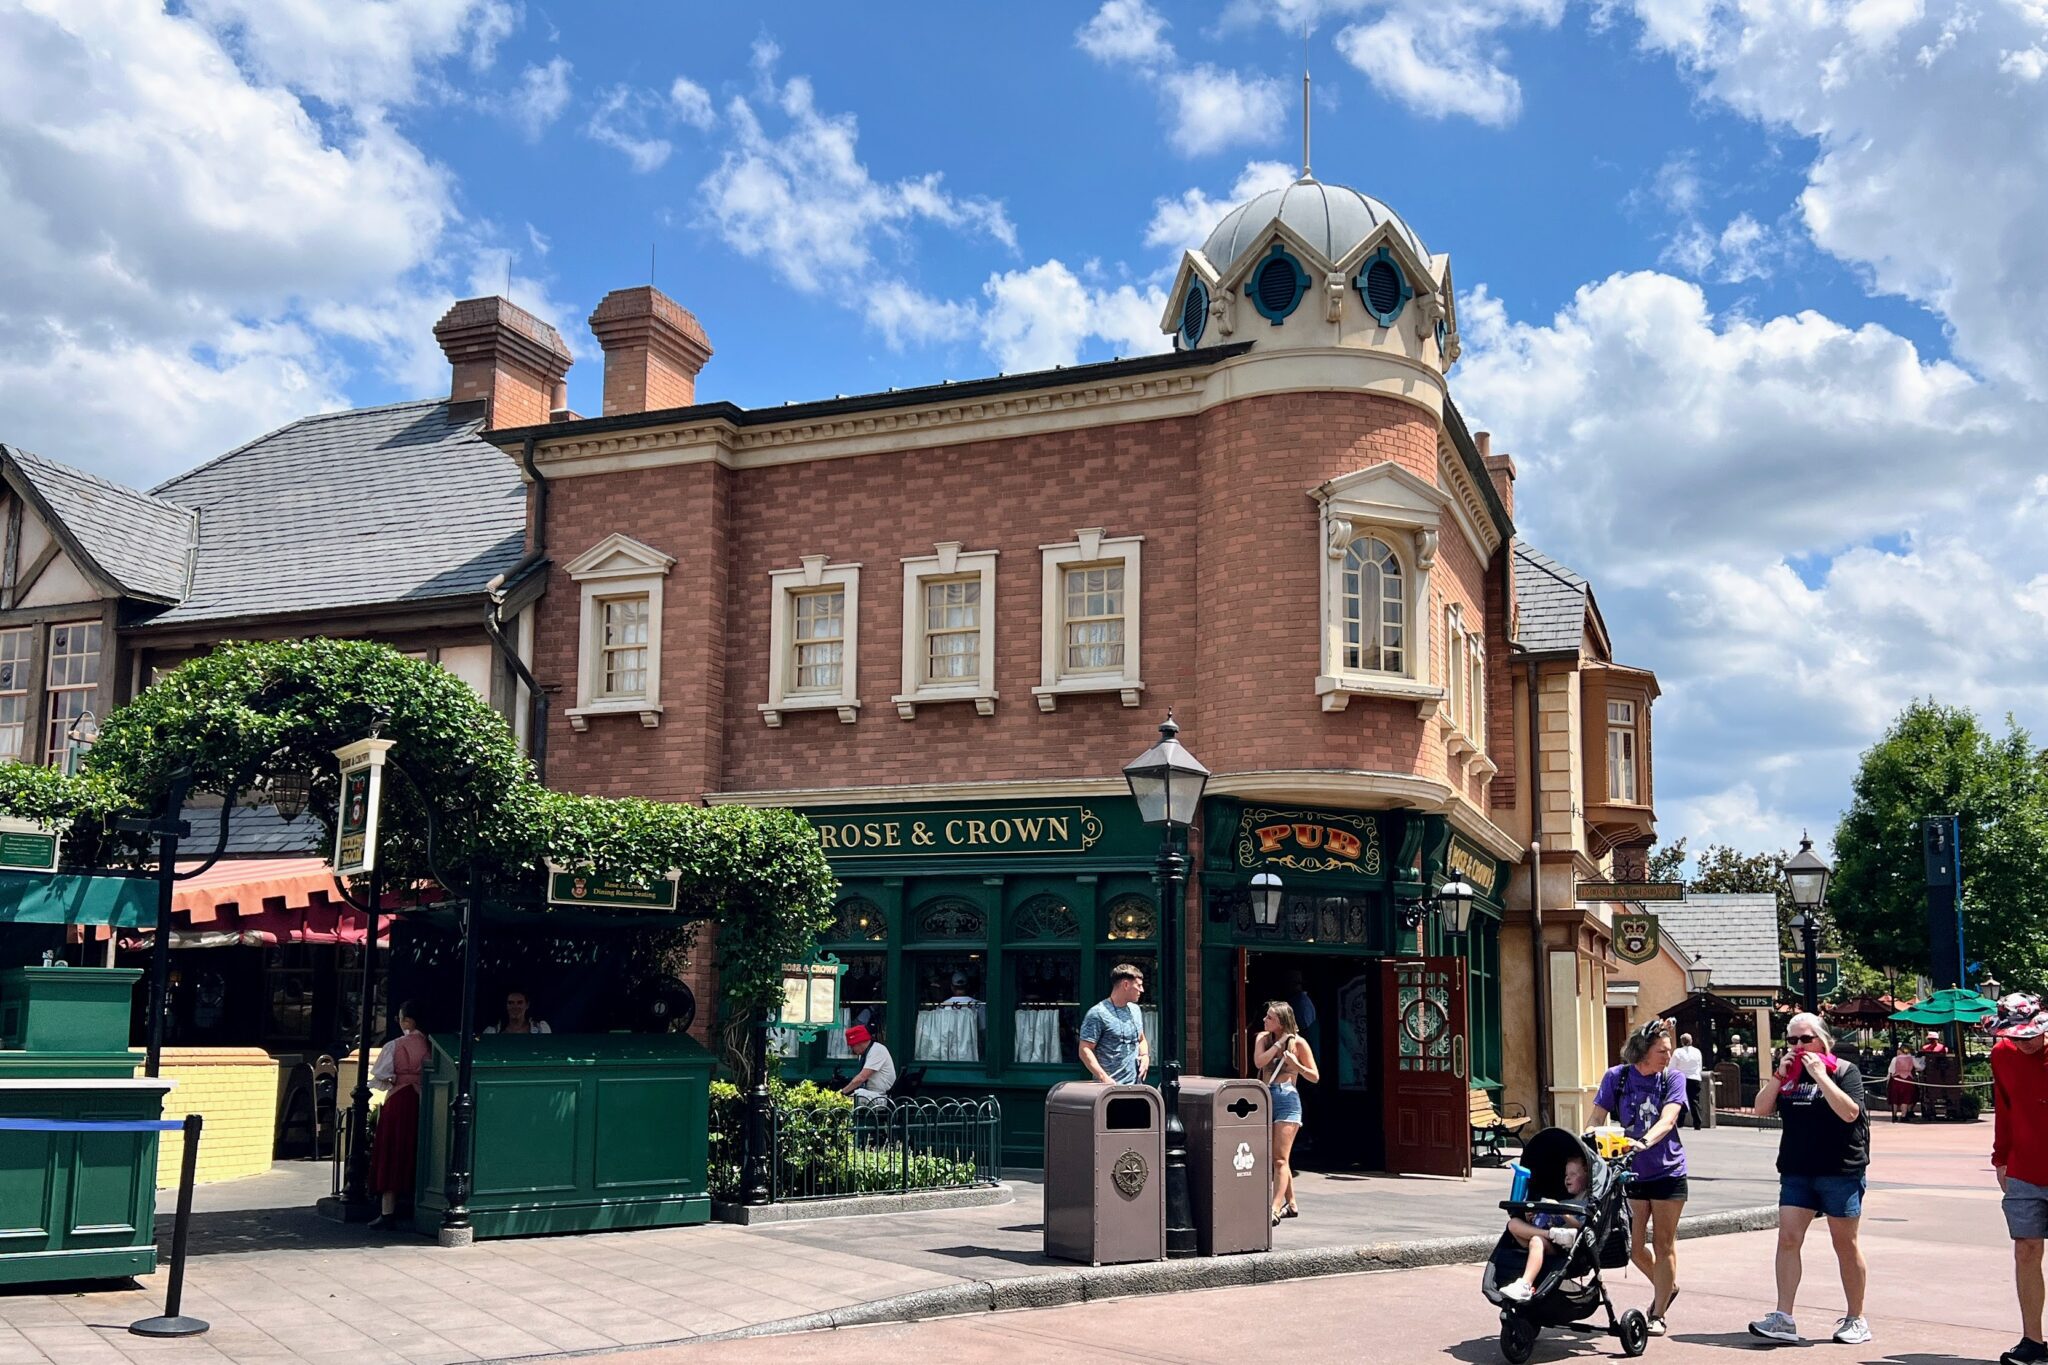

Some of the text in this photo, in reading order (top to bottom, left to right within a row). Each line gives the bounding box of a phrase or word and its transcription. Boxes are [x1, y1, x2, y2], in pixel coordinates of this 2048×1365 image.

[819, 816, 1070, 848] ROSE & CROWN
[1086, 822, 1096, 836] 9
[1255, 823, 1362, 860] PUB
[593, 888, 614, 896] Dining
[634, 890, 656, 899] Seating
[1582, 885, 1679, 897] ROSE & CROWN
[1739, 997, 1768, 1006] CHIPS
